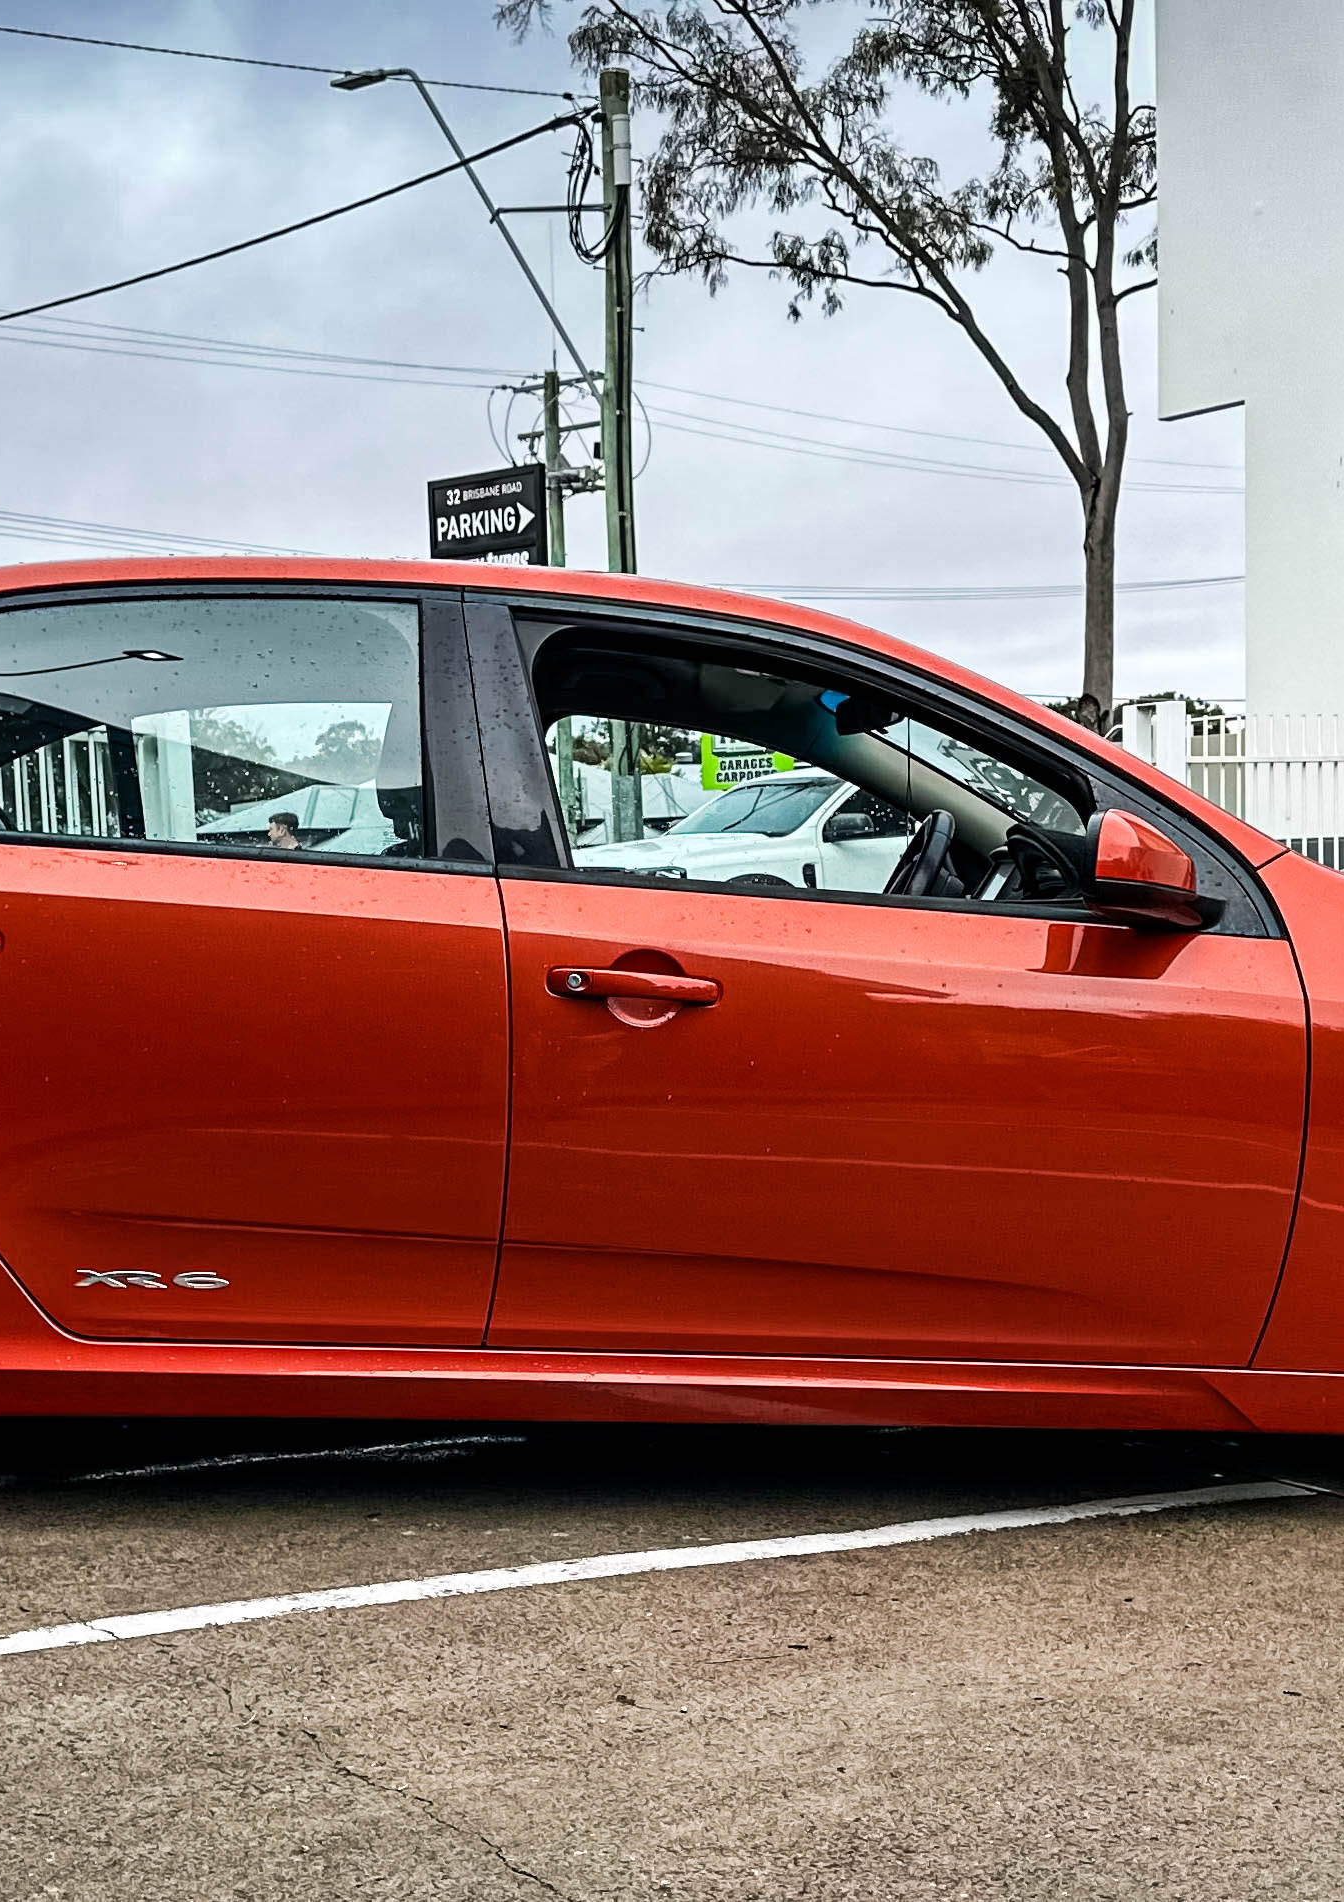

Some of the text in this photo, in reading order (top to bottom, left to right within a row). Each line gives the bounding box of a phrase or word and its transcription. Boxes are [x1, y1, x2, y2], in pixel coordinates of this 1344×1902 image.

[446, 481, 523, 506] 32 BRISBANE ROAD
[437, 506, 516, 541] PARKING
[719, 757, 773, 771] GARAGES
[716, 769, 778, 783] CARPOR
